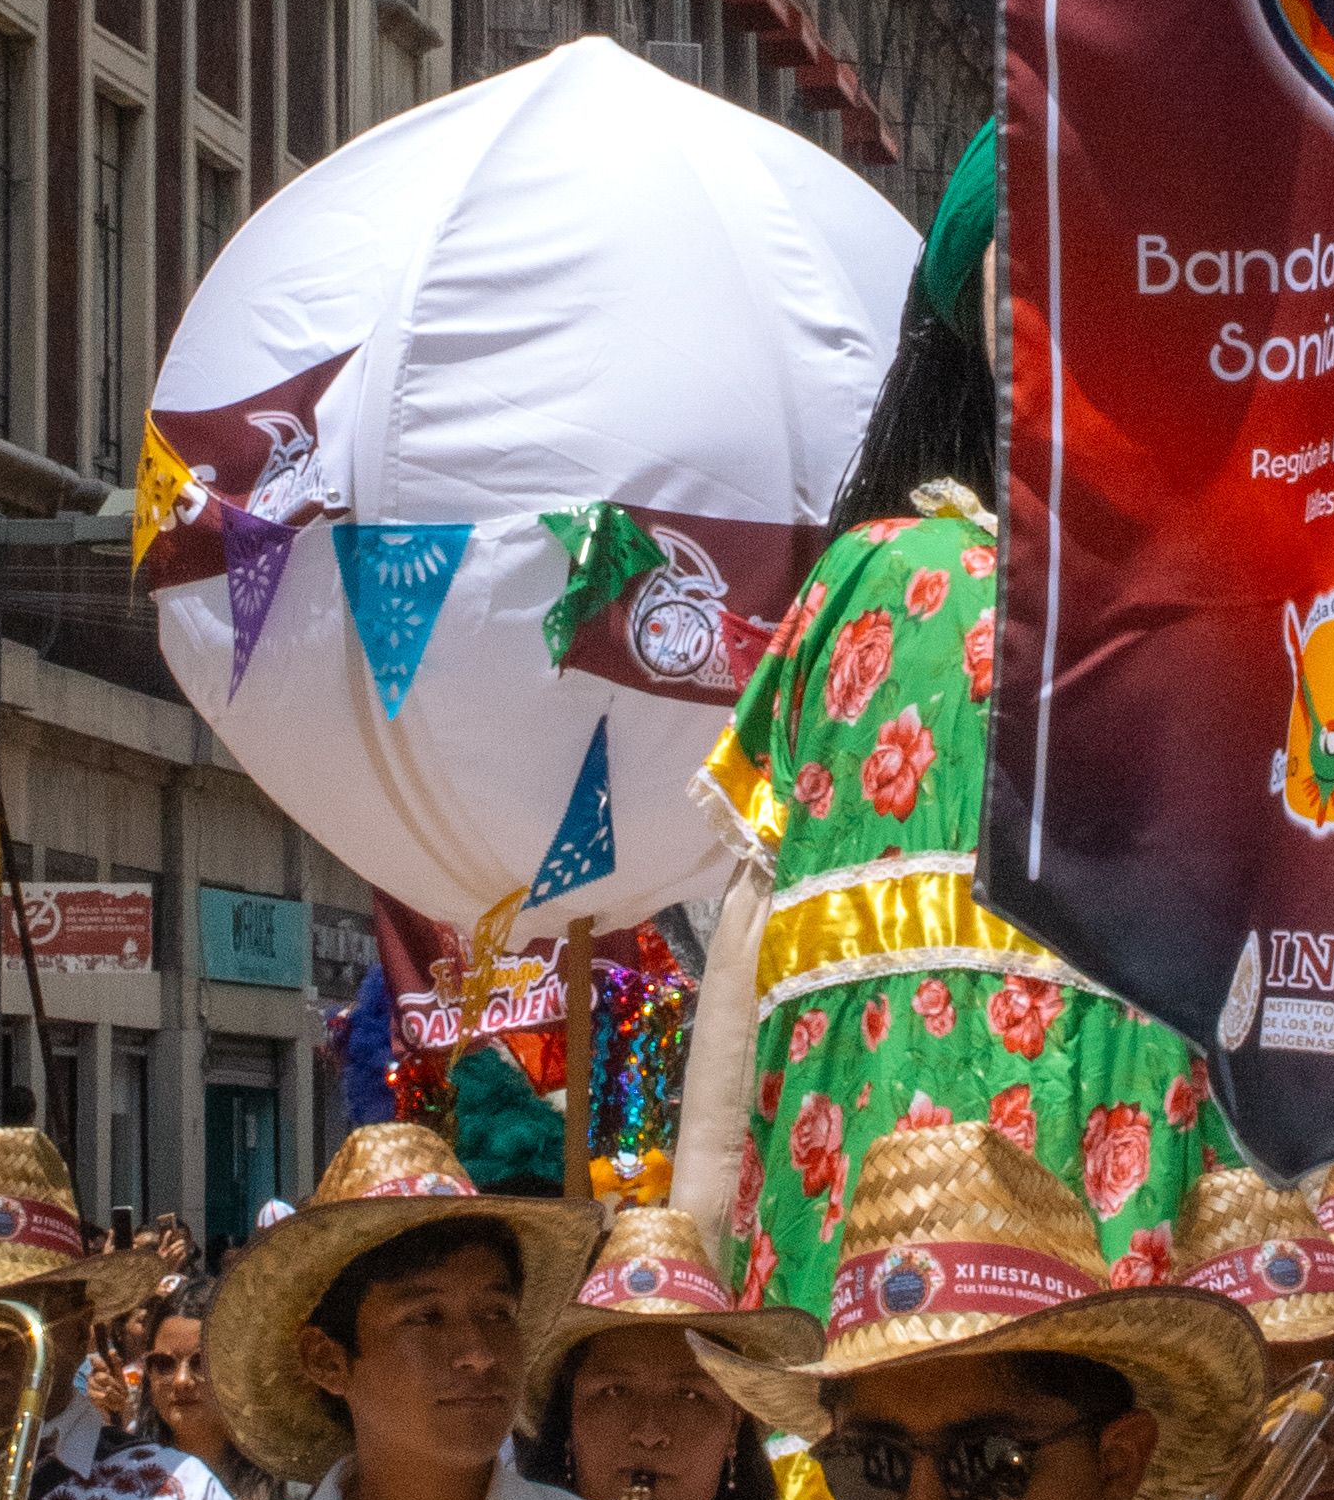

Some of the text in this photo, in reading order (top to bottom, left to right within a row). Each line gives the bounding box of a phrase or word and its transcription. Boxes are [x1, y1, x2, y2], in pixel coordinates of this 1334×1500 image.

[1281, 1018, 1308, 1031] LOS
[955, 1263, 976, 1279] XI
[980, 1263, 1042, 1288] FIESTA
[1045, 1275, 1065, 1295] DE
